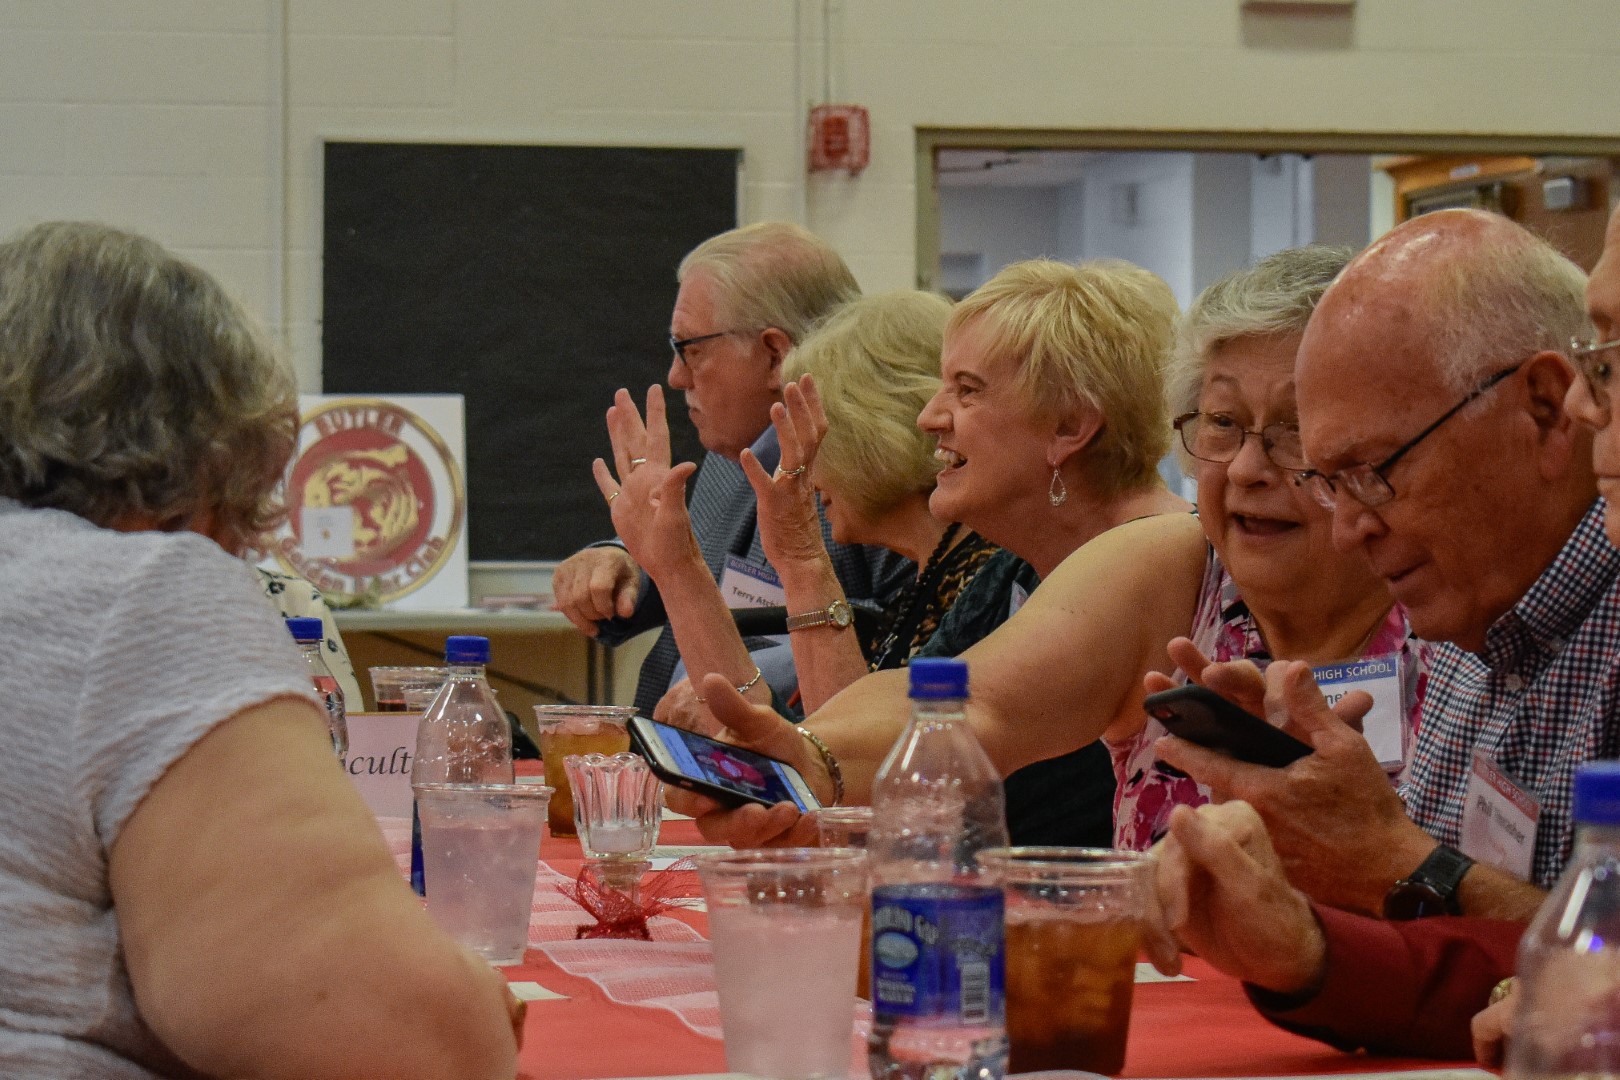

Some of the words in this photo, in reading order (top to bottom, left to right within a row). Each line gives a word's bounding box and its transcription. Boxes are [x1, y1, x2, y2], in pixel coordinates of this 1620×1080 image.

[314, 407, 405, 441] BUTLER
[730, 559, 757, 576] BUTLER
[354, 571, 402, 595] Bar
[732, 586, 755, 603] Terry
[1313, 668, 1343, 680] HIGH
[1346, 662, 1392, 677] SCHOOL
[1324, 690, 1348, 705] ne
